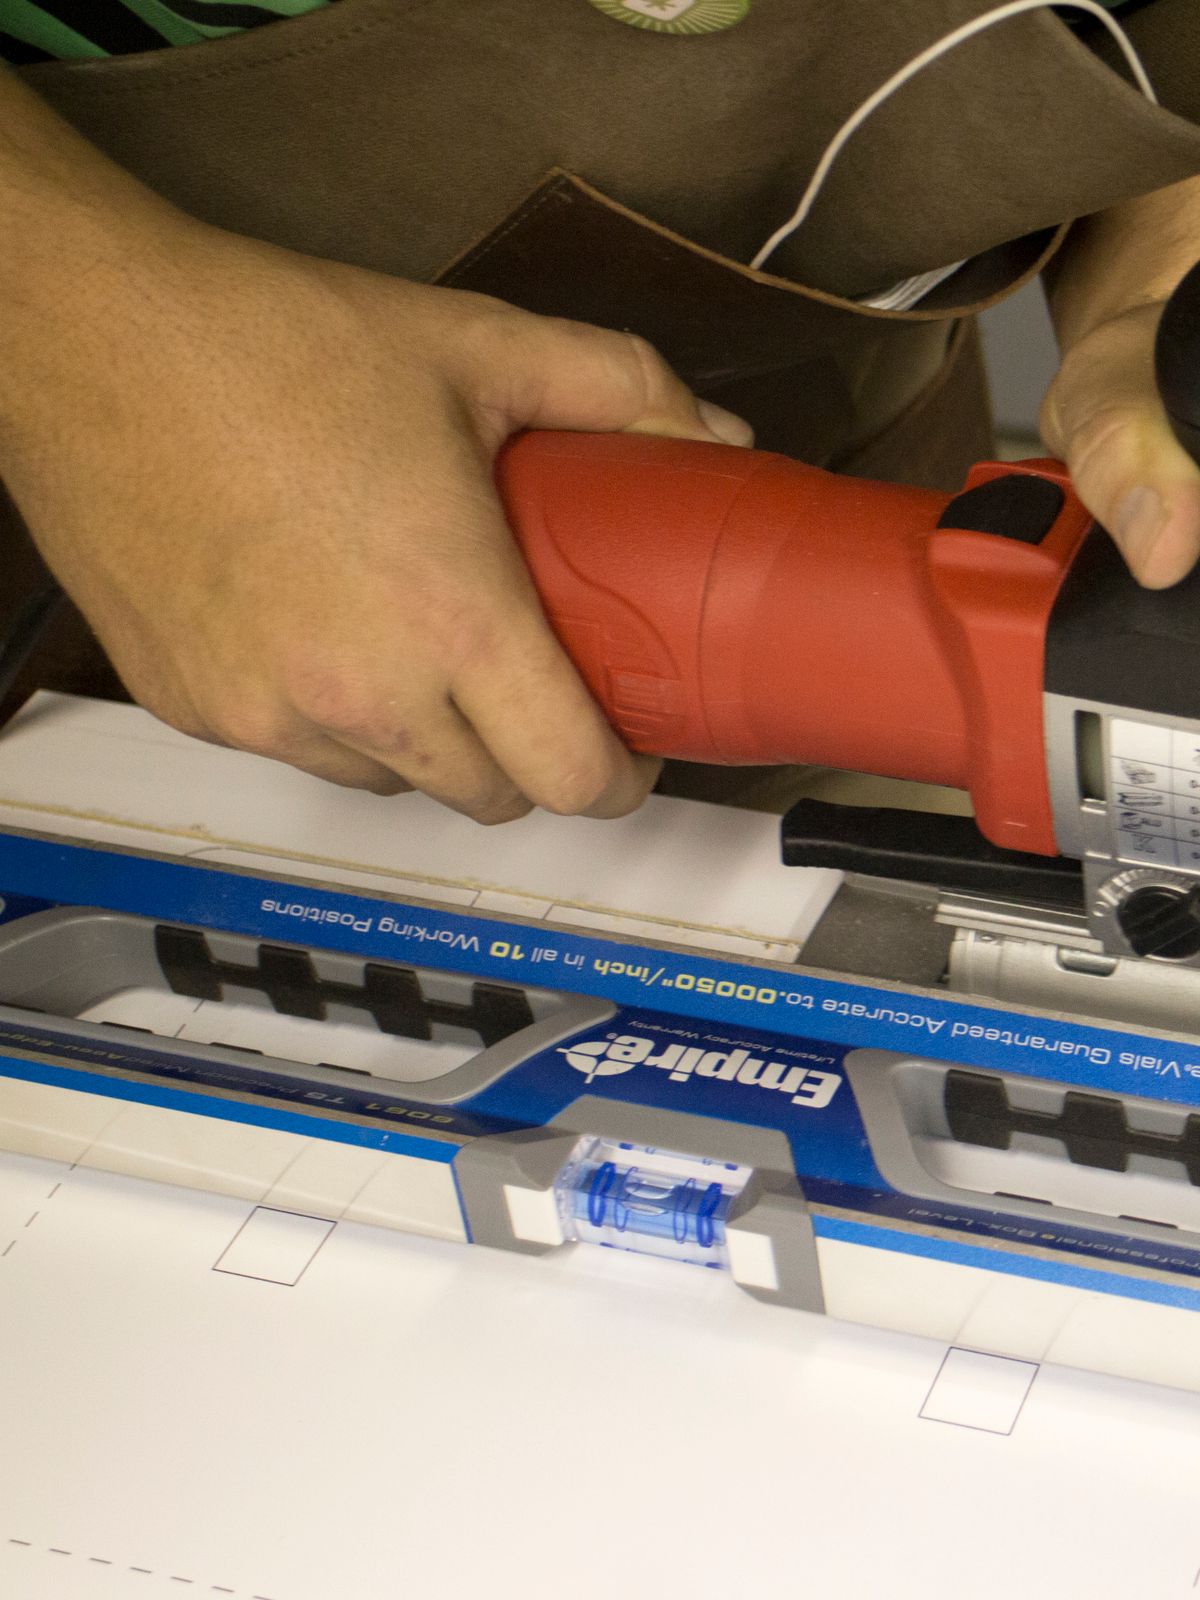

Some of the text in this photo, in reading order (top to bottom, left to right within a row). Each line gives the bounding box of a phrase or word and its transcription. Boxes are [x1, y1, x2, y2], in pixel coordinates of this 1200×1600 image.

[260, 899, 372, 933] Positions
[378, 917, 480, 952] Working
[489, 941, 525, 960] 10
[531, 947, 558, 963] all
[564, 952, 585, 970] in
[821, 999, 946, 1034] Accurate
[703, 1033, 772, 1053] Accuracy
[775, 1048, 836, 1064] Lifetime
[950, 1022, 1112, 1065] Guaranteed
[604, 1034, 842, 1109] Empire
[1119, 1052, 1181, 1078] Vials
